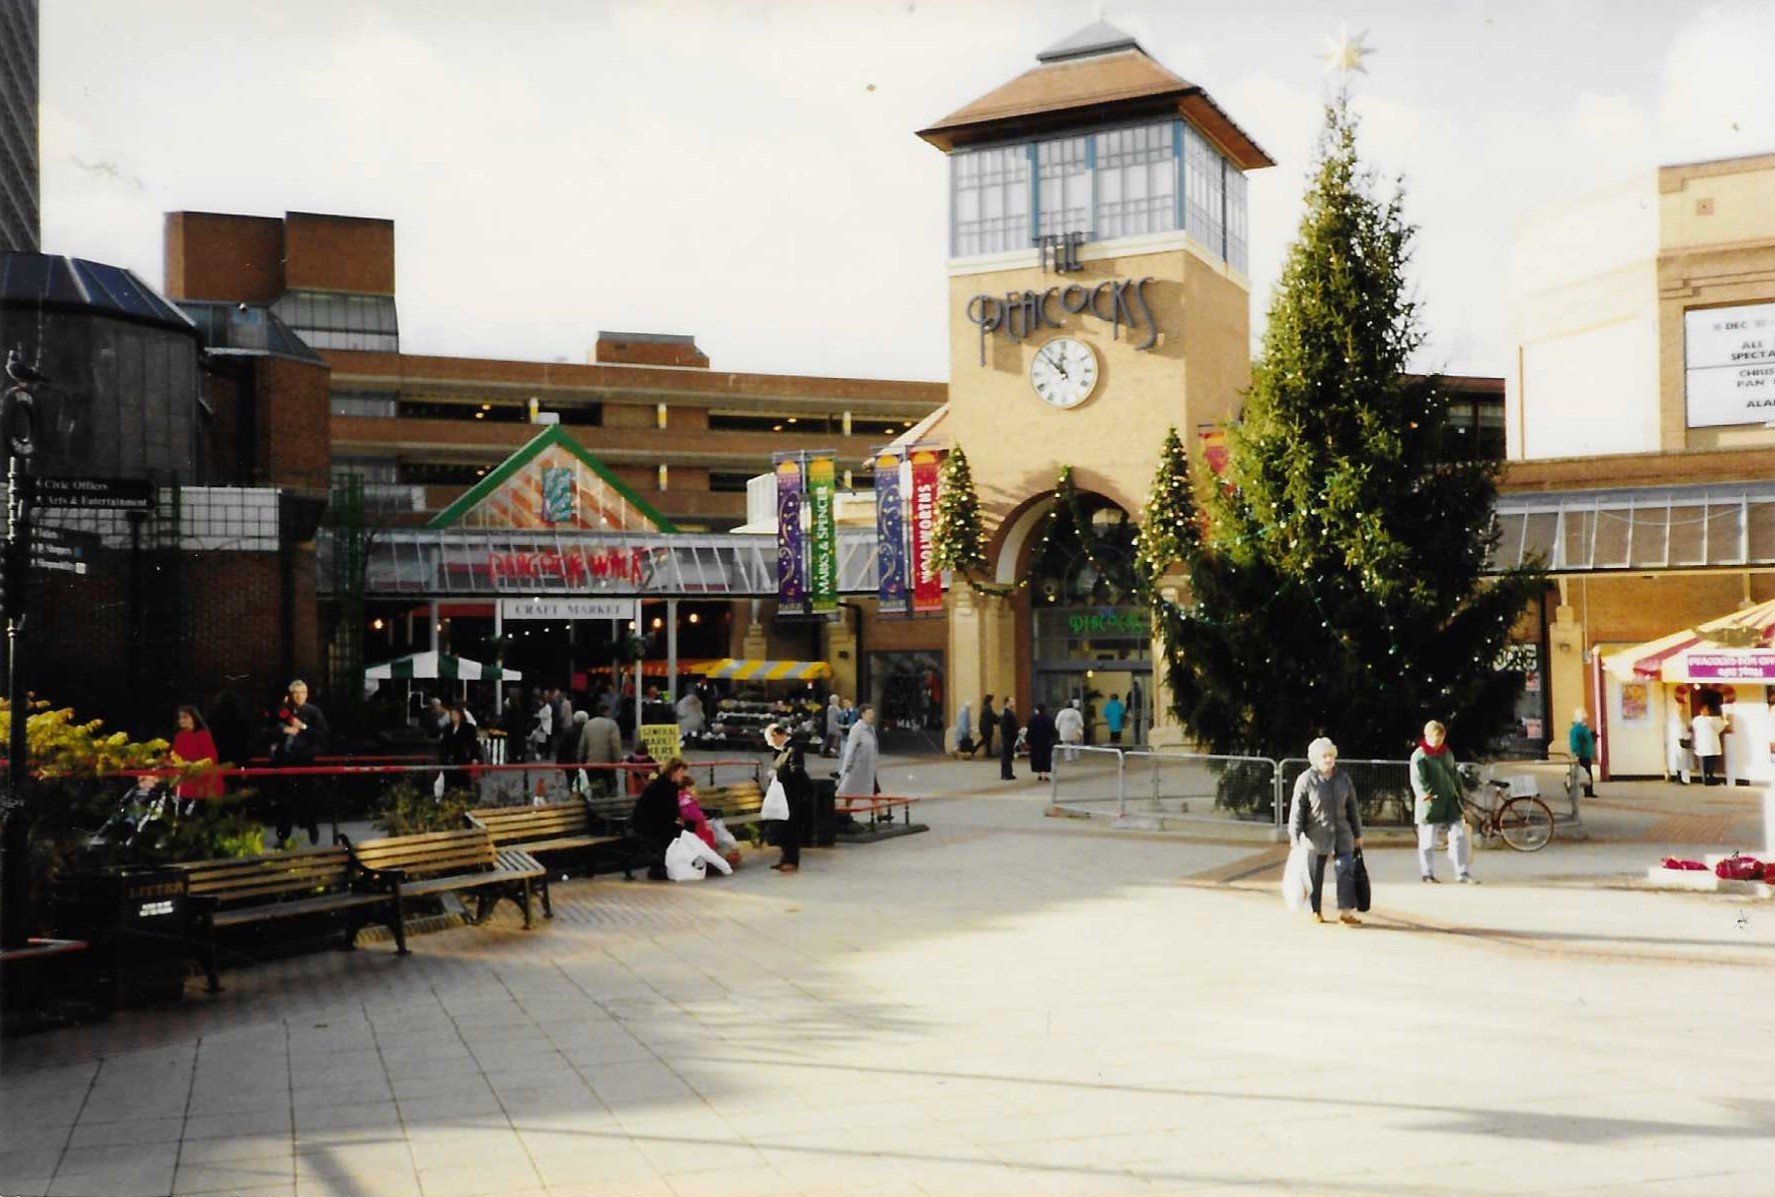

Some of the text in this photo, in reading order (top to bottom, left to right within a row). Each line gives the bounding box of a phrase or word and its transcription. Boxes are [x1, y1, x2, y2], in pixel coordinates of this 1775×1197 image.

[1040, 231, 1085, 274] THE
[966, 276, 1156, 368] PEACOCKS
[1725, 321, 1748, 330] DEC
[1747, 399, 1775, 408] ALA
[44, 479, 69, 490] Civic
[816, 486, 830, 595] MARKS & SPENCER
[515, 604, 622, 615] CRAFT MARKET
